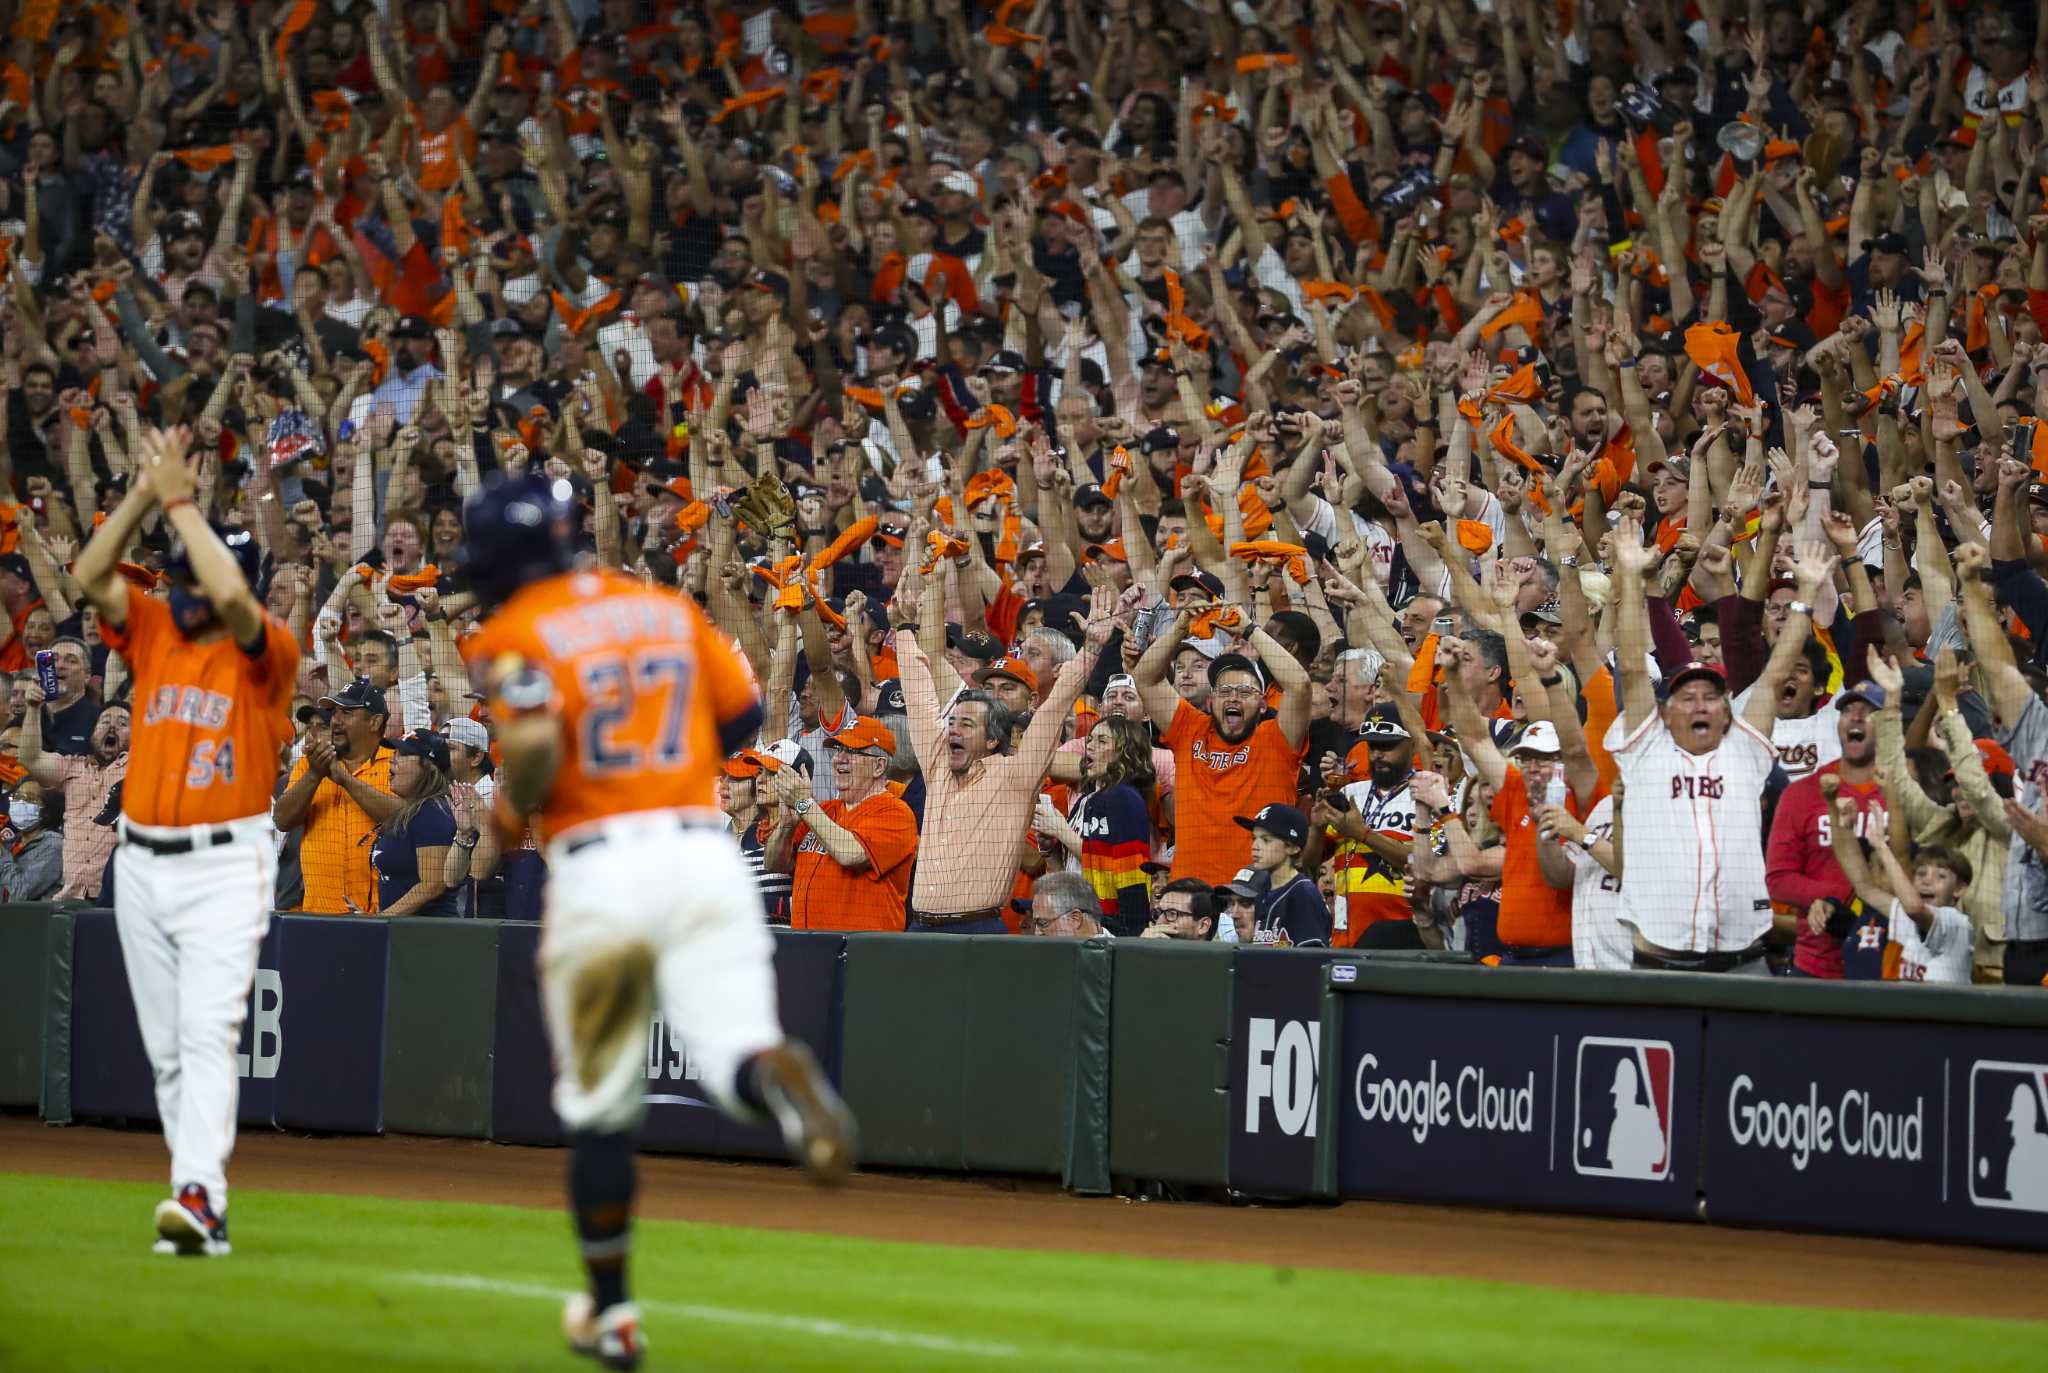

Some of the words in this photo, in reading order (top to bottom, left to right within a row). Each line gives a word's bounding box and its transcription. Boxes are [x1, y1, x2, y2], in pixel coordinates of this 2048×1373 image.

[577, 647, 697, 772] 27
[186, 737, 235, 789] 54
[1355, 1052, 1452, 1144] Google
[1456, 1065, 1534, 1133] Cloud
[1728, 1073, 1834, 1171] Google
[1838, 1088, 1923, 1161] Cloud
